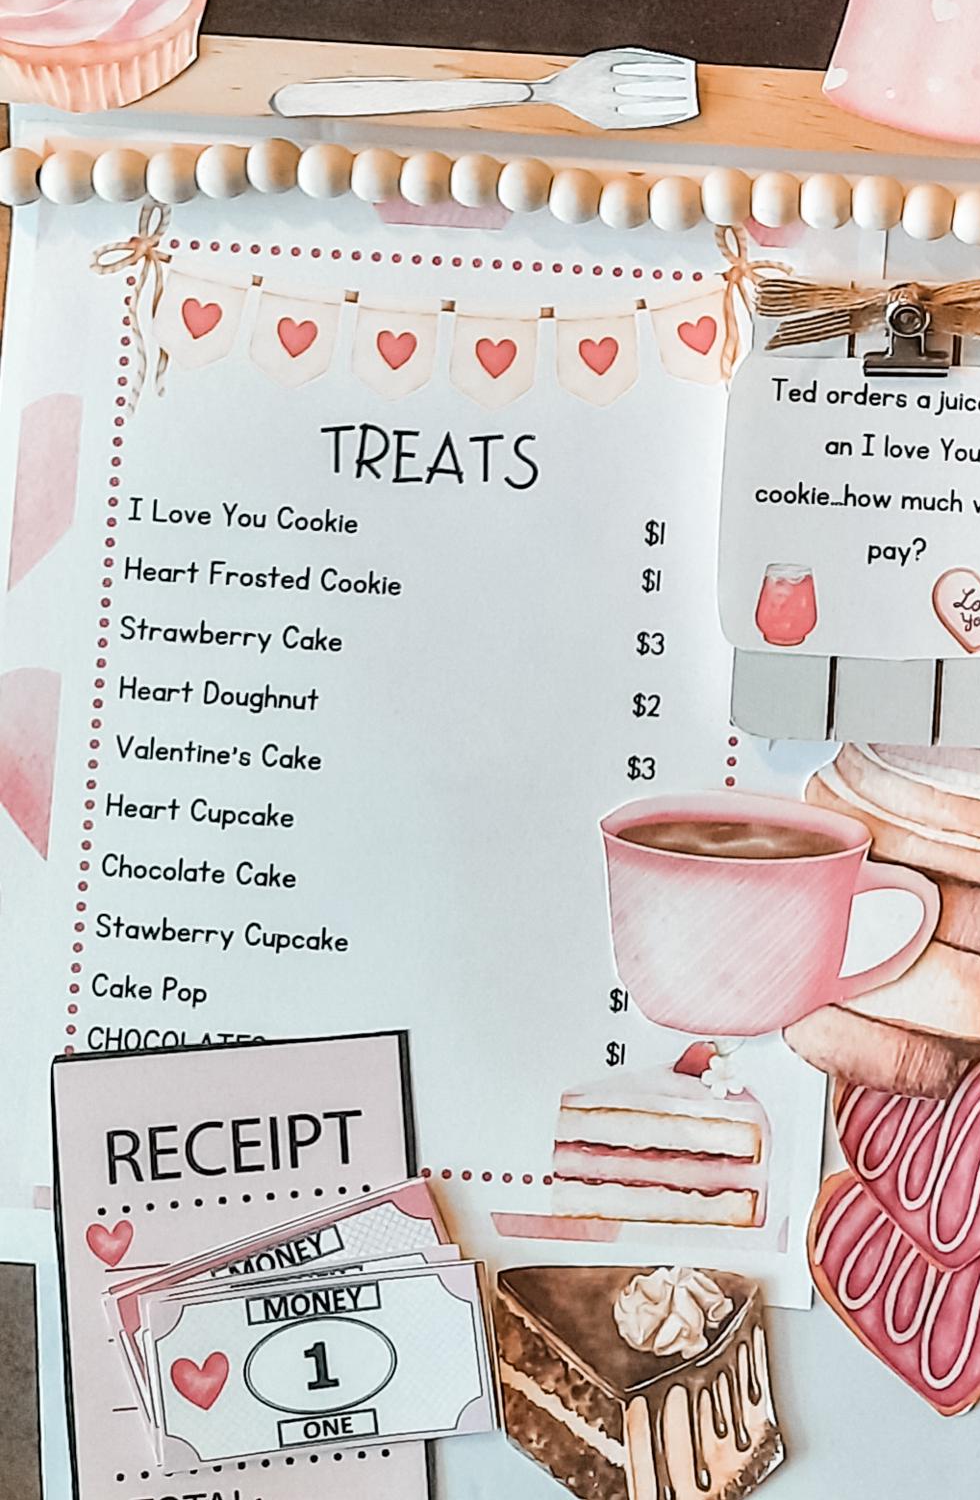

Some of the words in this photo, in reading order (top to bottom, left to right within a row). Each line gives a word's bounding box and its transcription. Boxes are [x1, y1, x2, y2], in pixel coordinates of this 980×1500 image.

[771, 377, 818, 403] Ted
[826, 382, 907, 408] orders
[916, 394, 931, 409] a
[320, 423, 539, 490] TREATS
[825, 441, 853, 456] an
[861, 433, 876, 457] I
[884, 434, 930, 460] love
[128, 497, 143, 521] I
[152, 498, 212, 526] Love
[222, 502, 267, 528] You
[277, 506, 358, 534] Cookie
[901, 489, 963, 513] much
[644, 519, 666, 547] $1
[867, 537, 927, 567] pay?
[124, 556, 200, 584] Heart
[209, 560, 311, 591] Frosted
[320, 567, 402, 596] Cookie
[641, 568, 662, 594] $1
[120, 615, 272, 654] Strawberry
[282, 625, 342, 652] Cake
[636, 631, 665, 656] $3
[119, 675, 194, 703] Heart
[203, 680, 319, 714] Doughnut
[632, 692, 661, 718] $2
[116, 734, 251, 767] Valentine's
[261, 743, 322, 771] Cake
[627, 755, 656, 781] $3
[105, 792, 181, 821] Heart
[190, 798, 294, 830] Cupcake
[101, 853, 225, 884] Chocolate
[236, 861, 296, 889] Cake
[95, 913, 235, 951] Stawberry
[244, 922, 349, 954] Cupcake
[91, 972, 152, 1000] Cake
[162, 977, 207, 1008] Pop
[609, 987, 629, 1014] $1
[605, 1041, 626, 1067] $1
[106, 1109, 363, 1185] RECEIPT
[229, 1230, 322, 1275] MONEY
[263, 1288, 361, 1321] MONEY
[303, 1341, 341, 1391] 1
[303, 1416, 354, 1439] ONE
